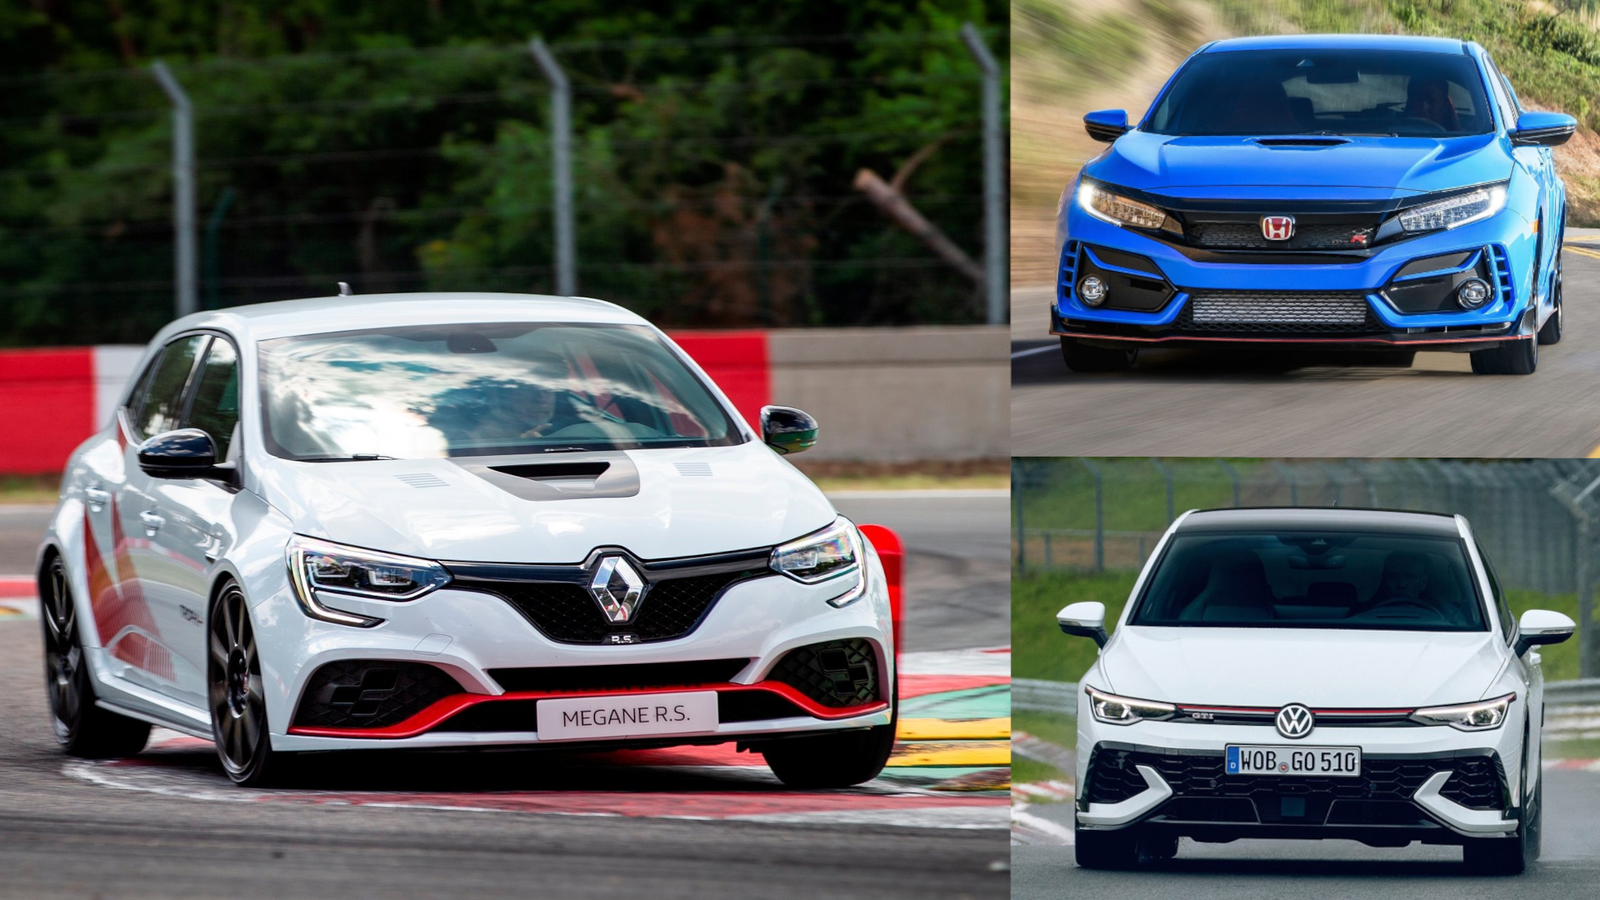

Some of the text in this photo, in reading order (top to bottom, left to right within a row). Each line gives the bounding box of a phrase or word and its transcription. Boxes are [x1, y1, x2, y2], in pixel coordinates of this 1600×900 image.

[562, 704, 691, 727] MEGANE R.S.
[1192, 712, 1214, 720] GTI
[1241, 750, 1356, 772] WOB GO 510
